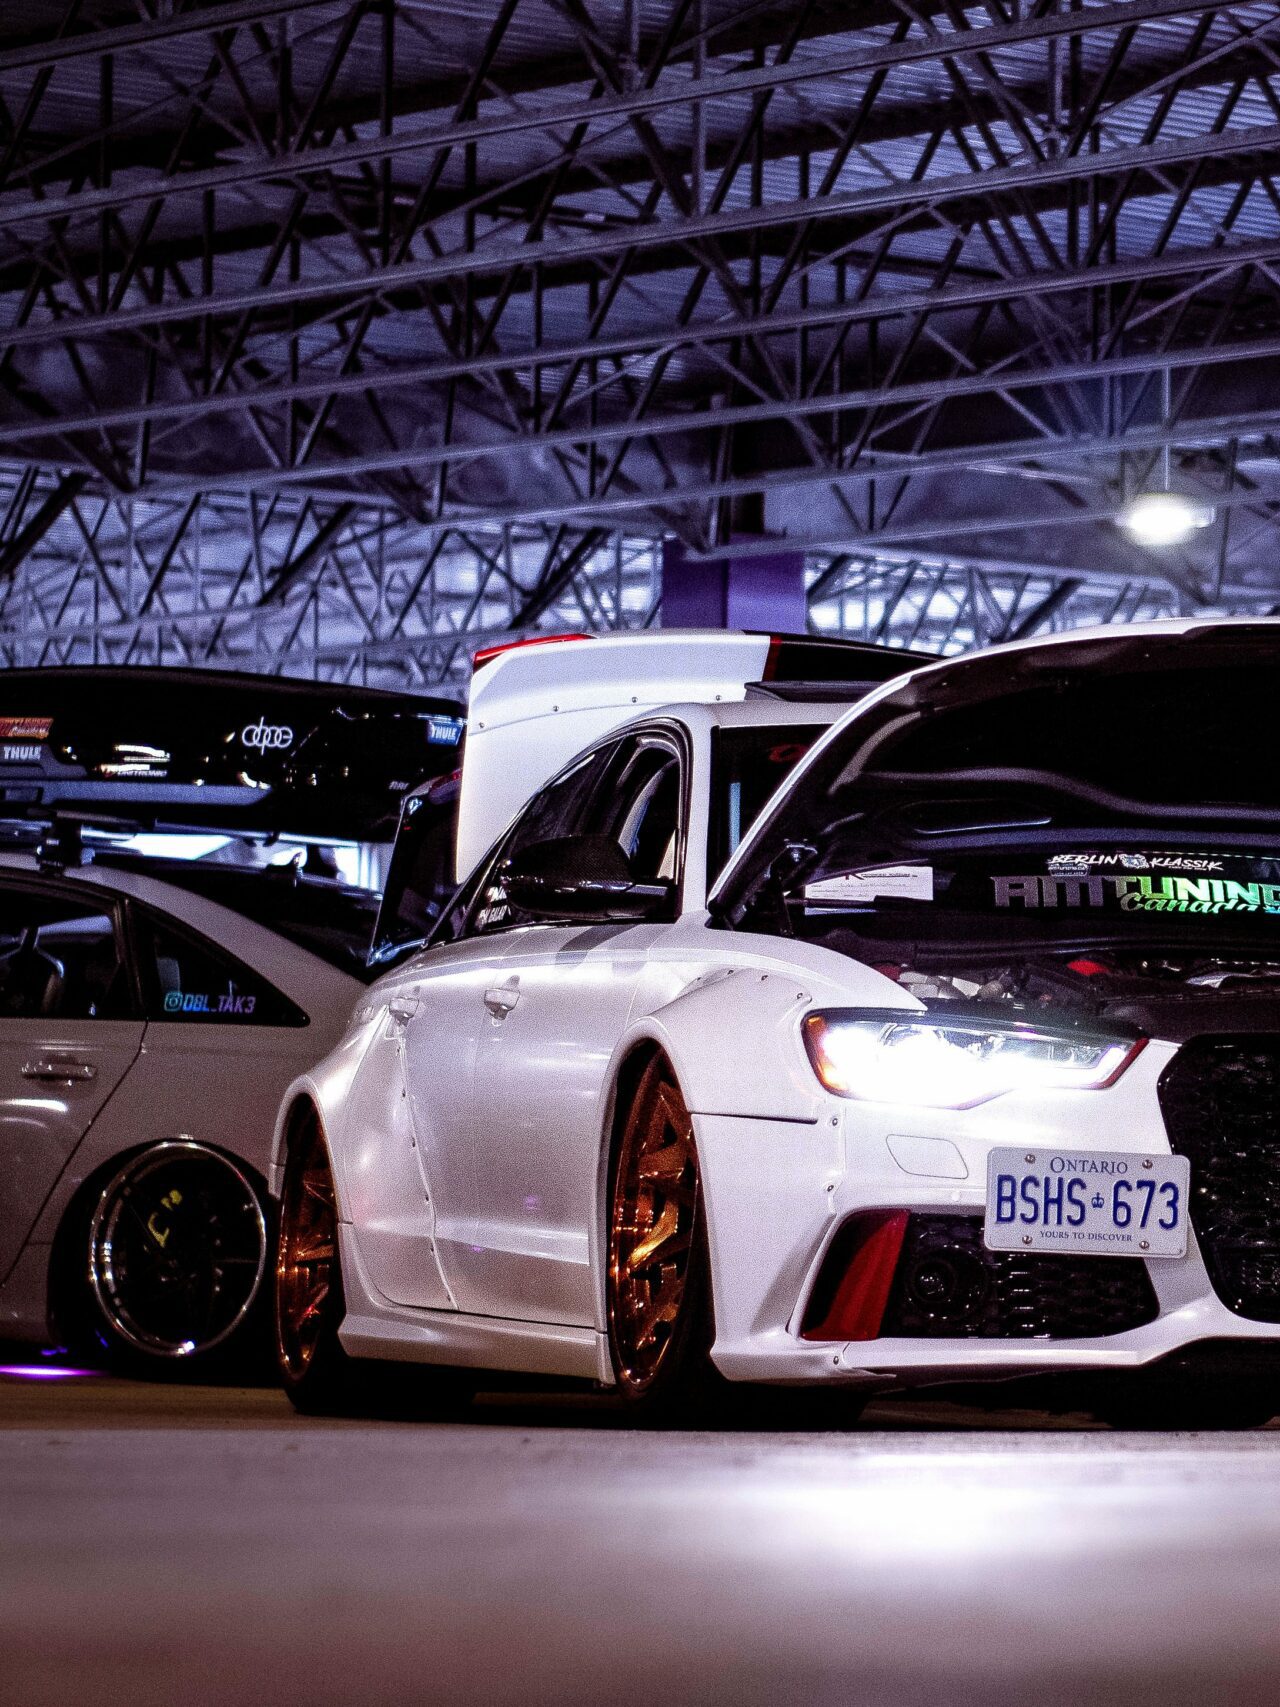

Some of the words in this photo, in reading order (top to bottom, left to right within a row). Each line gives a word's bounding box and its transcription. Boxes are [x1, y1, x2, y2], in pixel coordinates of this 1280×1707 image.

[431, 725, 458, 740] THULE
[3, 745, 42, 760] THULE
[1048, 853, 1119, 865] BERLIN
[1150, 857, 1224, 871] KLASSIK
[1050, 1156, 1128, 1175] ONTARIO
[995, 1174, 1087, 1227] BSHS
[1112, 1179, 1180, 1230] 673
[1039, 1230, 1069, 1239] YOURS
[1073, 1231, 1085, 1240] TO
[1087, 1232, 1132, 1242] DISCOVER
